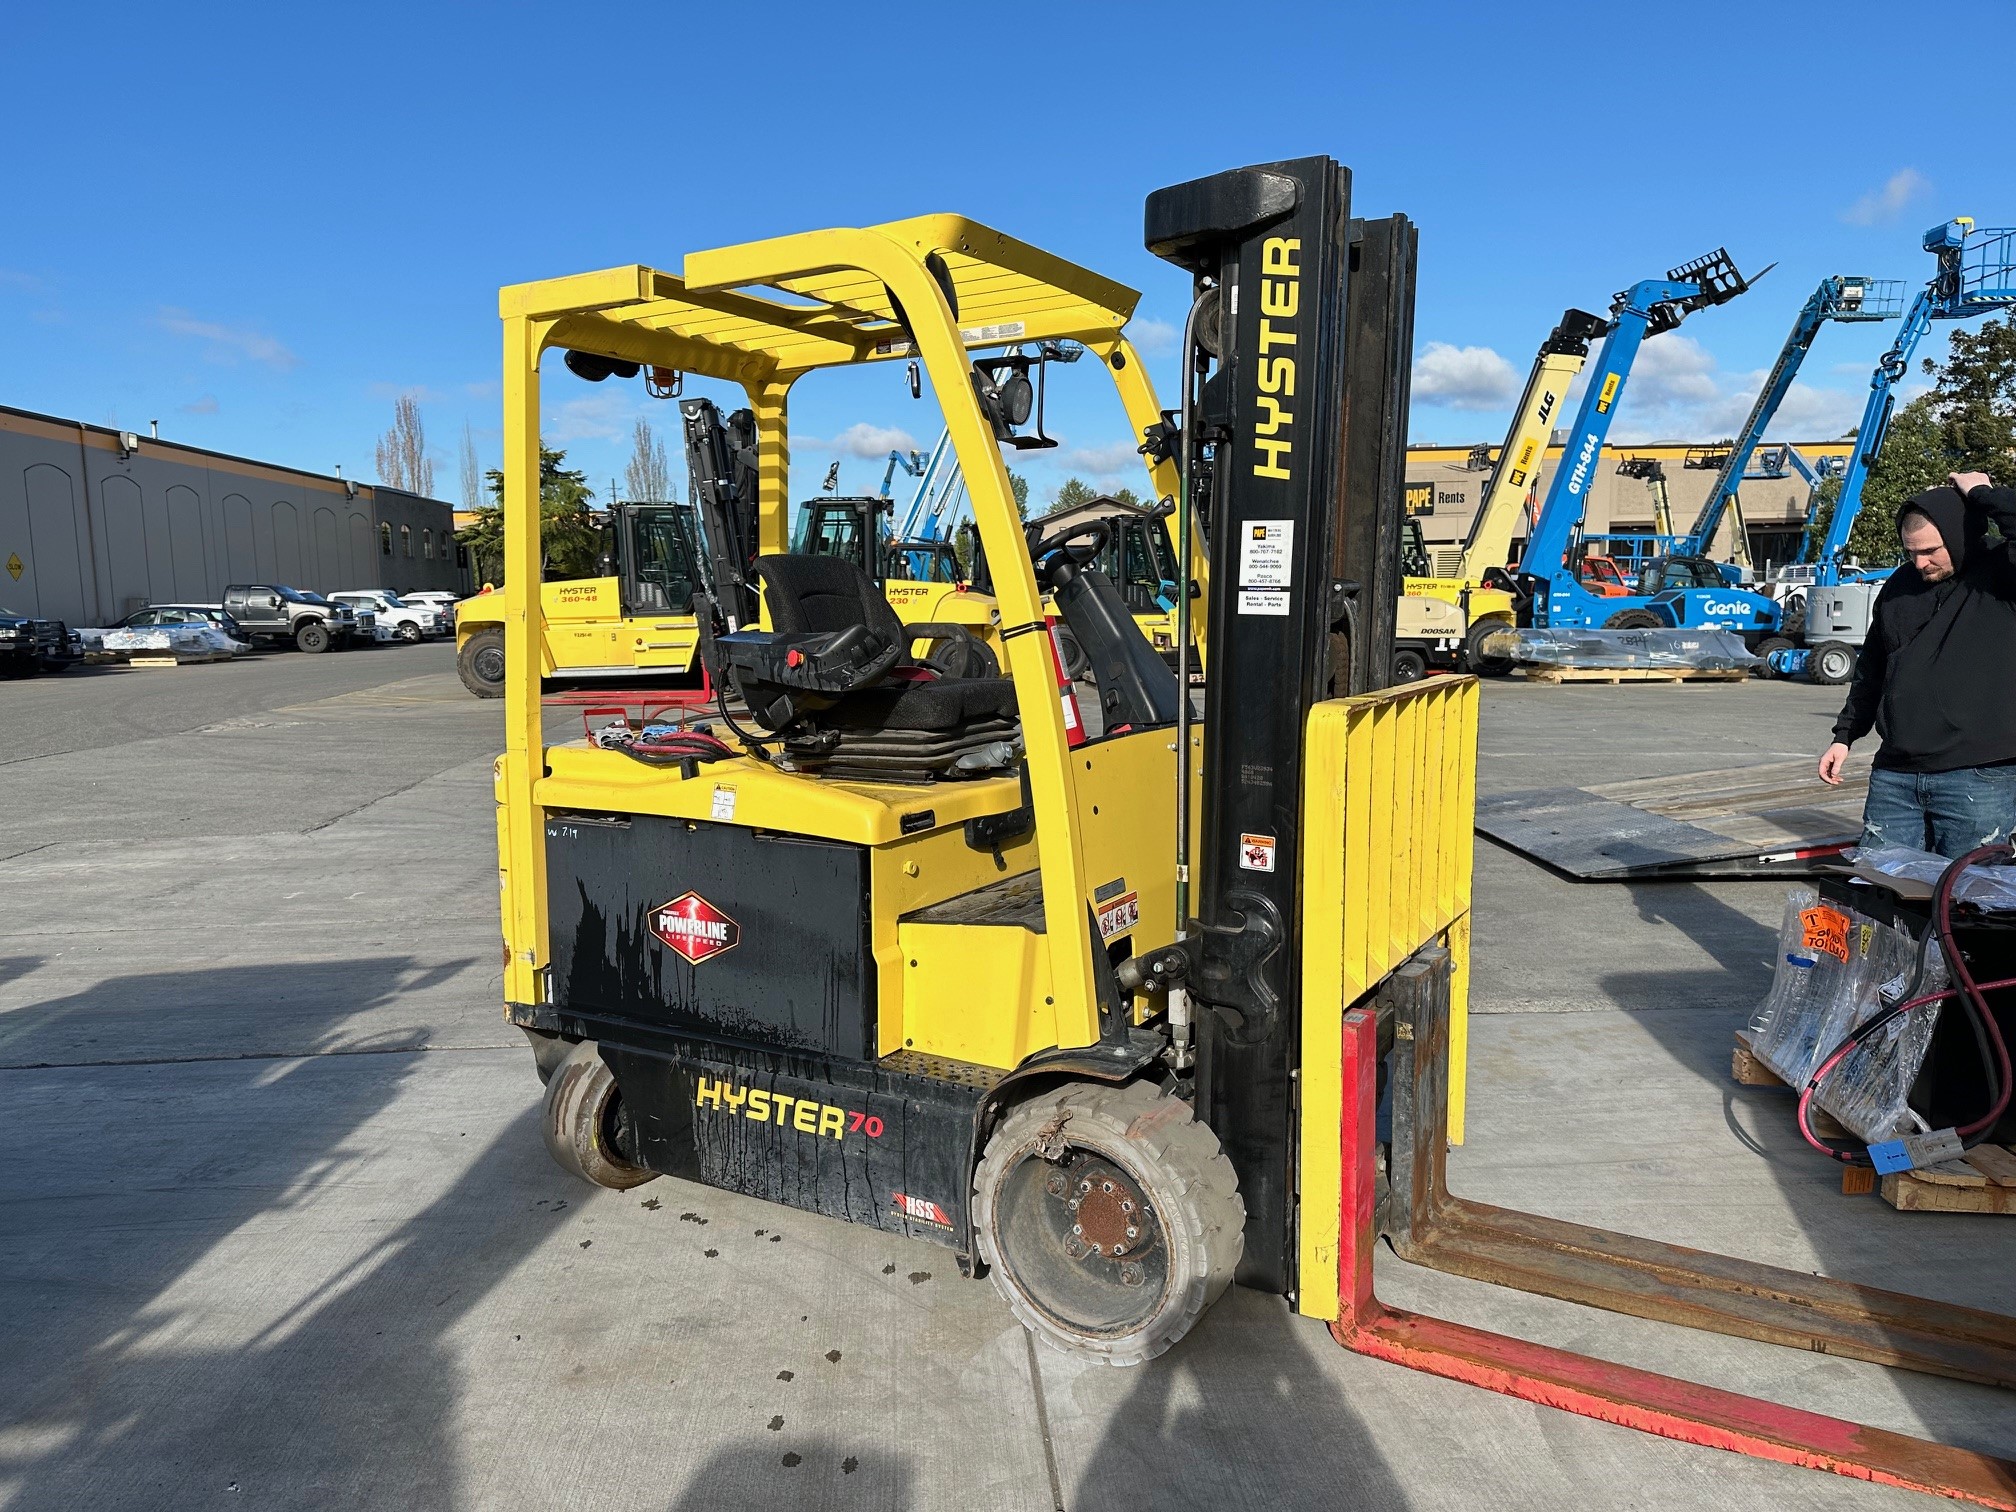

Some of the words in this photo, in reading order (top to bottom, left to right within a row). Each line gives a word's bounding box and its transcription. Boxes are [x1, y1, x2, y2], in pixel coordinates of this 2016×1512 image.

[1254, 237, 1301, 480] HYSTER
[1538, 391, 1555, 425] JLG
[1520, 446, 1533, 465] Rents
[1568, 433, 1599, 495] GTH-844
[1438, 492, 1465, 504] Rents
[560, 587, 597, 595] HYSTER
[561, 595, 598, 603] 360-48
[889, 588, 929, 596] HYSTER
[889, 597, 909, 605] 230
[1704, 599, 1751, 616] Genie
[659, 914, 728, 941] POWERLINE
[696, 1077, 845, 1140] HYSTER
[847, 1111, 884, 1138] 70
[905, 1195, 935, 1221] HSS
[934, 1222, 954, 1232] SYSTEM
